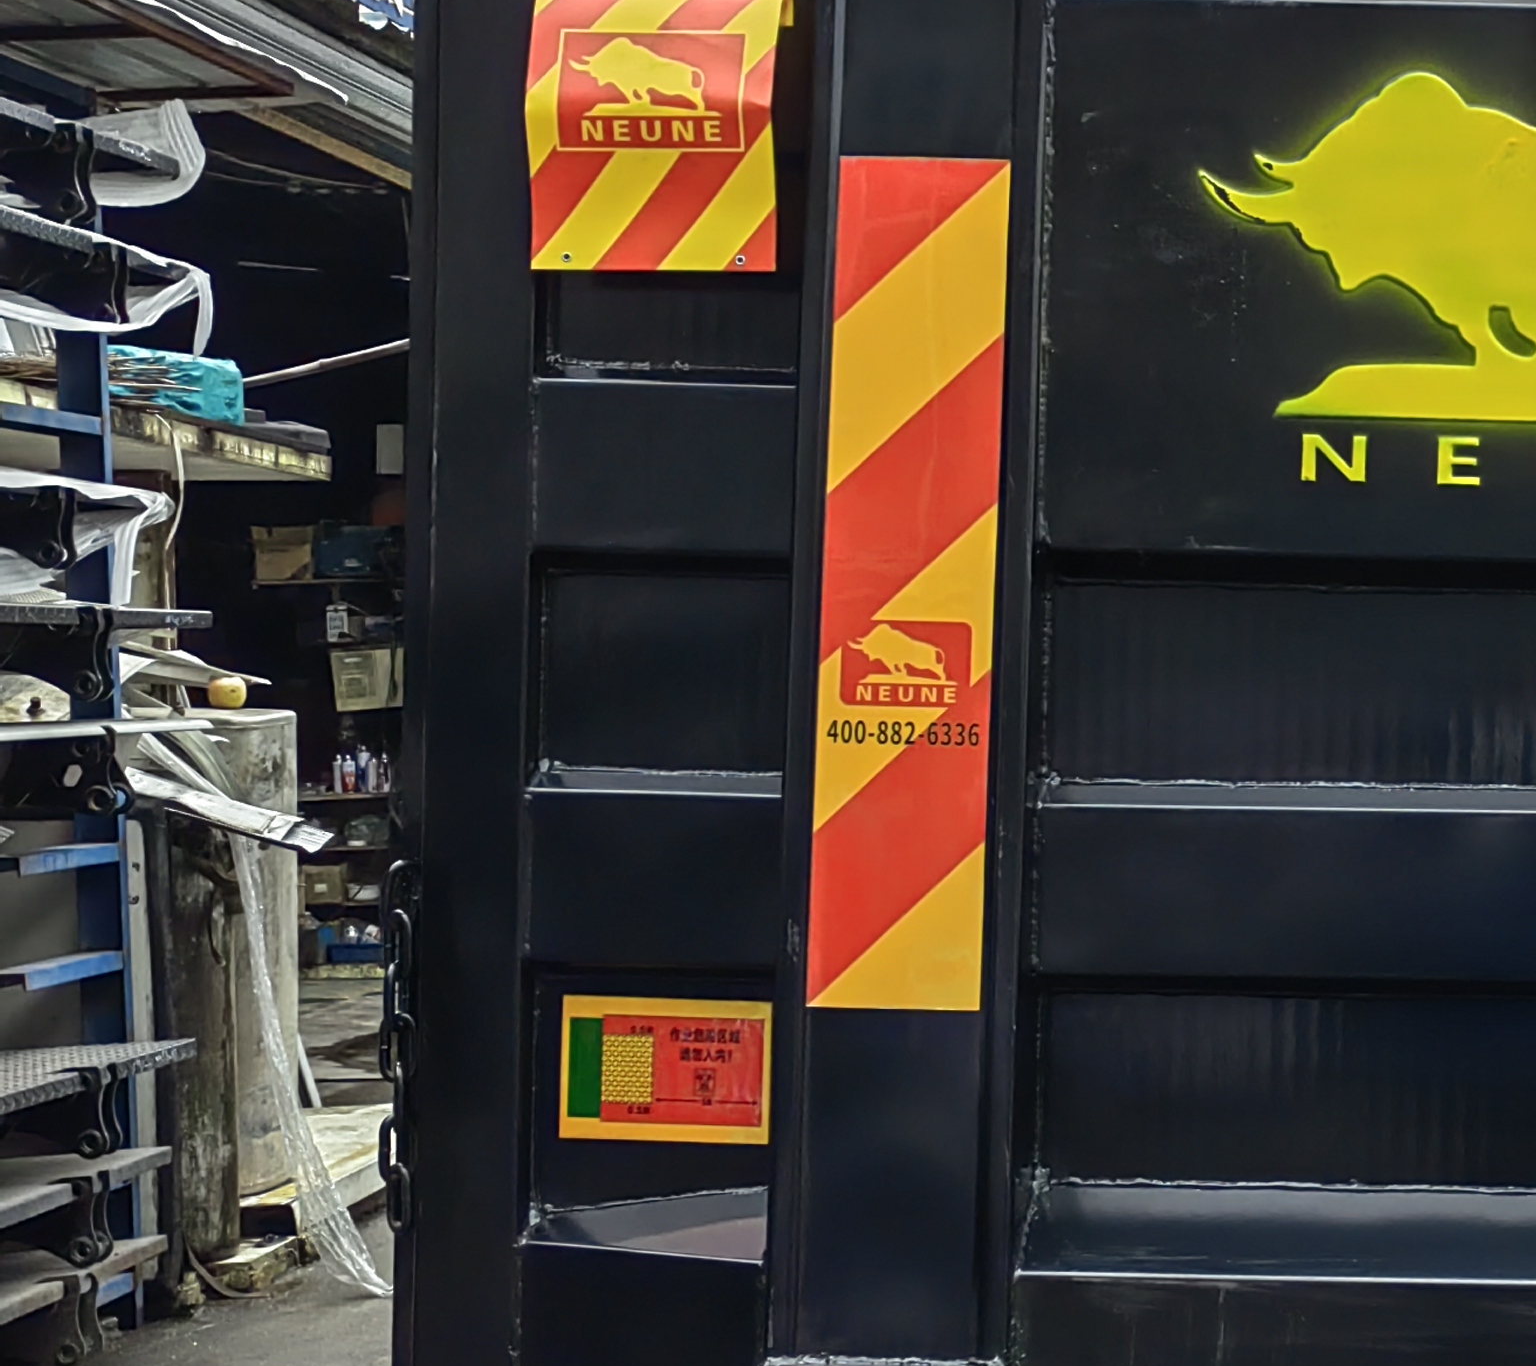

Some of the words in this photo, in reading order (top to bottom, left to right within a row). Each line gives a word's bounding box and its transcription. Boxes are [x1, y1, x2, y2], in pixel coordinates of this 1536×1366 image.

[581, 119, 722, 142] NEUNE
[856, 685, 957, 703] NEUNE
[826, 720, 980, 746] 400-882-6336
